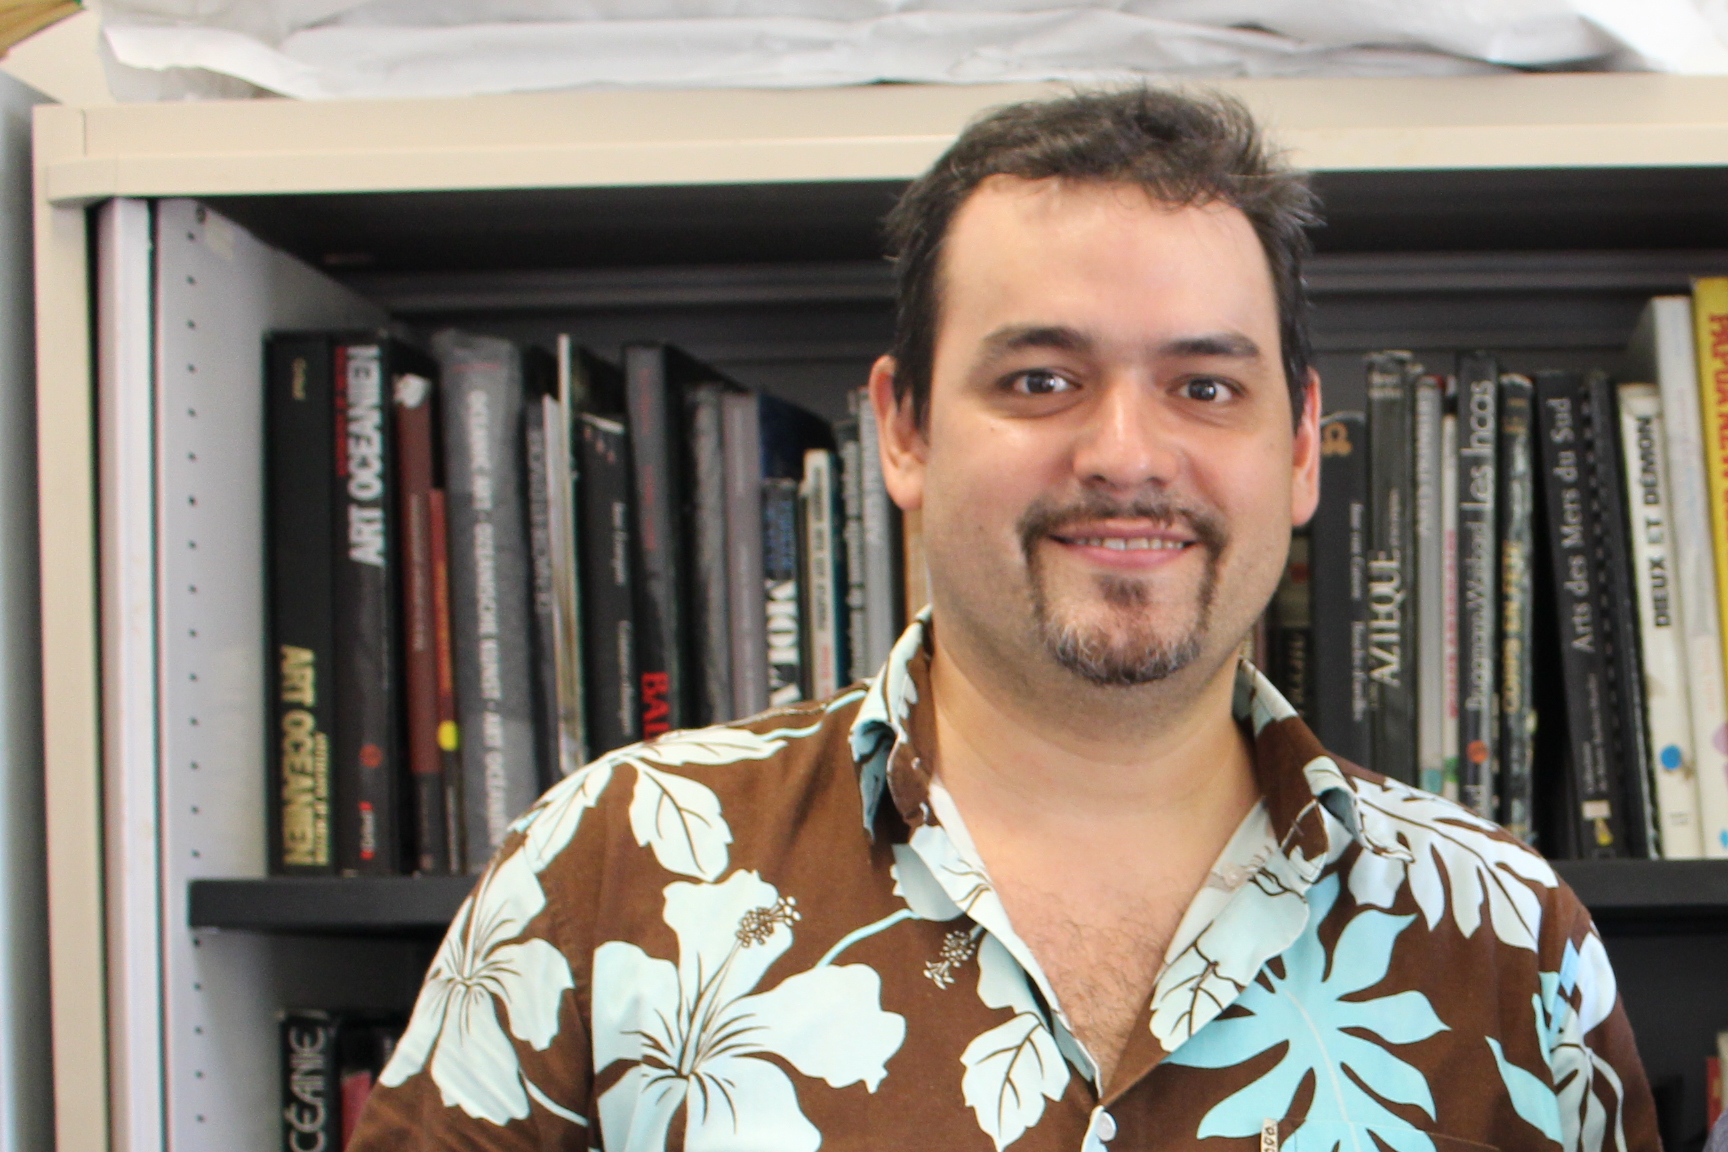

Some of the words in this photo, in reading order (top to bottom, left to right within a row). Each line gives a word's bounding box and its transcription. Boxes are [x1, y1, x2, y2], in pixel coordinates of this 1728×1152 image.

[346, 345, 381, 500] OCEANIEN
[1460, 380, 1493, 457] Incas
[1547, 397, 1574, 443] Sud
[1460, 465, 1493, 511] Les
[1553, 451, 1579, 483] du
[347, 503, 385, 566] ART
[1557, 489, 1585, 548] Mers
[1644, 518, 1664, 544] ET
[1563, 555, 1589, 596] des
[1649, 557, 1671, 628] DIEUX
[1570, 603, 1596, 653] Arts
[280, 645, 316, 707] ART
[281, 711, 317, 865] OCEANIEN
